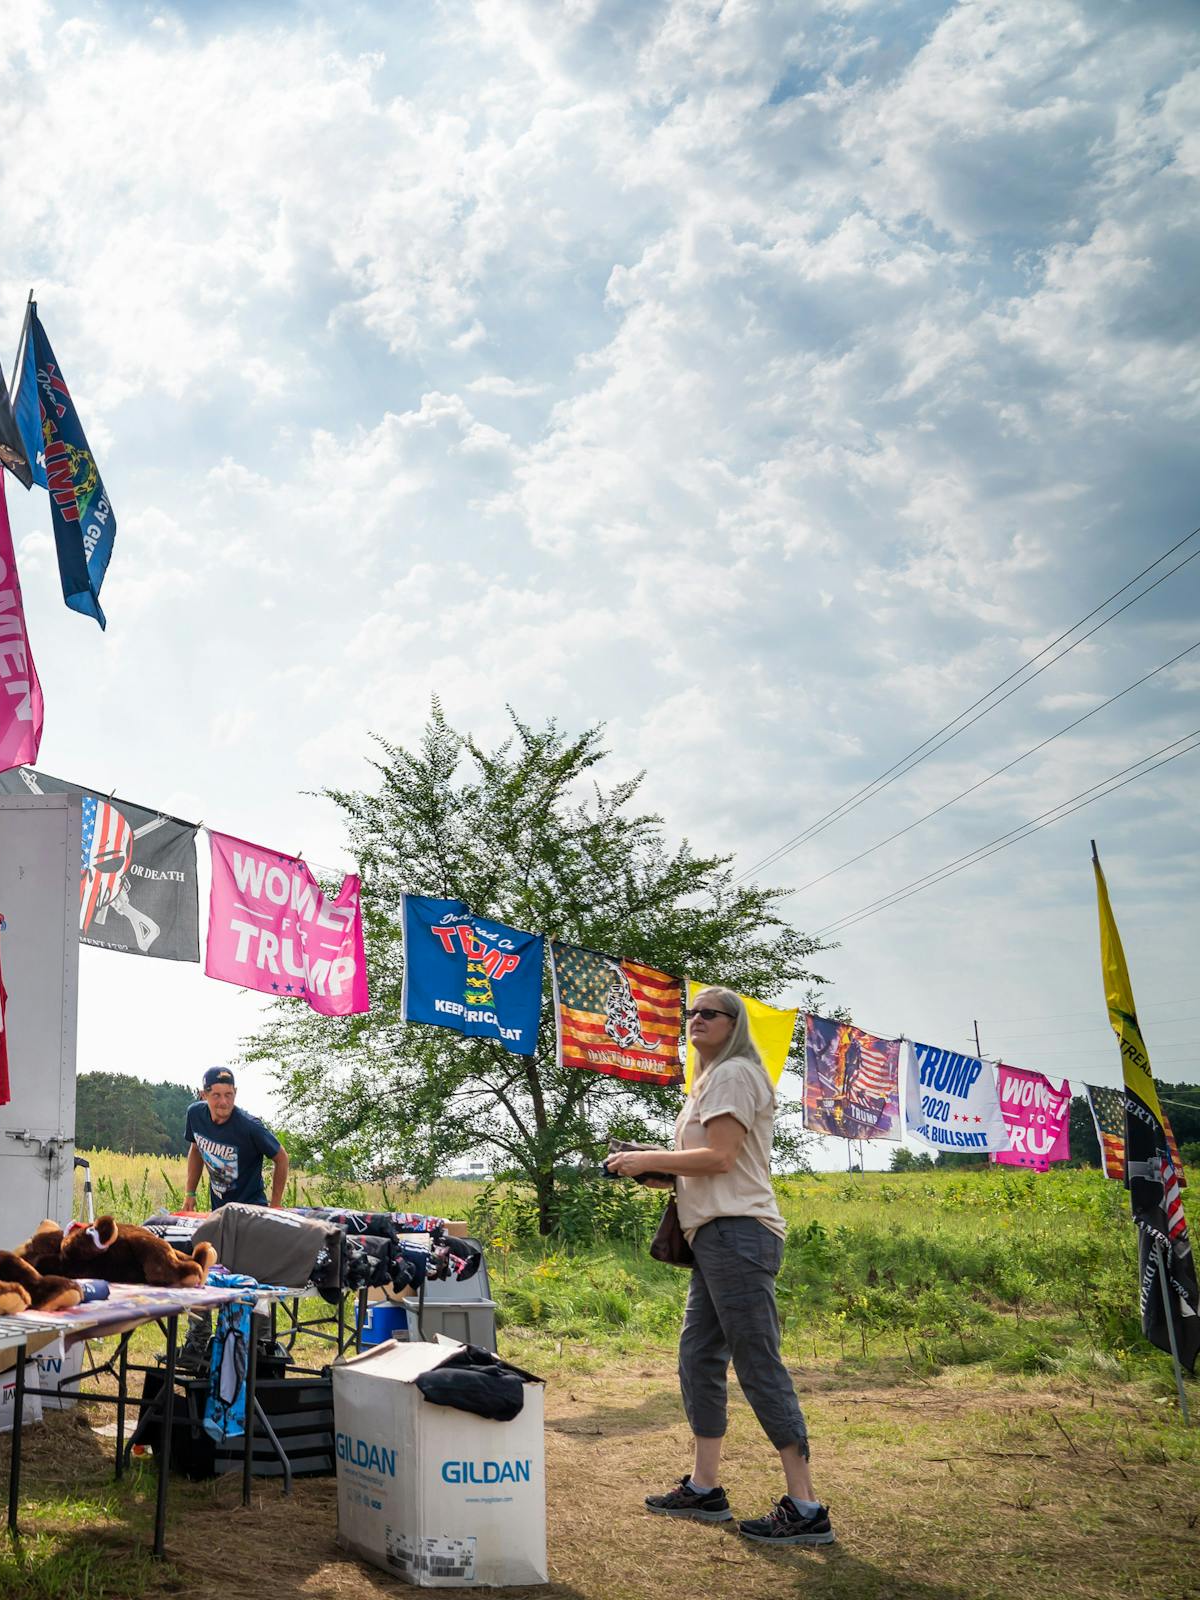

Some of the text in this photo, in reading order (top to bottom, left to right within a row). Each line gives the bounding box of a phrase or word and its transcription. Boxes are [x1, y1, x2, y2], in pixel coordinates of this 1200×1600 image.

[130, 864, 186, 883] OR DEATH
[229, 919, 357, 997] TRUMP
[914, 1042, 983, 1100] TRUMP
[850, 1103, 879, 1126] TRUMP
[921, 1095, 951, 1123] 2020
[194, 1134, 235, 1160] TRUMP
[931, 1125, 989, 1148] BULLSHIT
[336, 1432, 396, 1478] GILDAN
[440, 1459, 531, 1484] GILDAN
